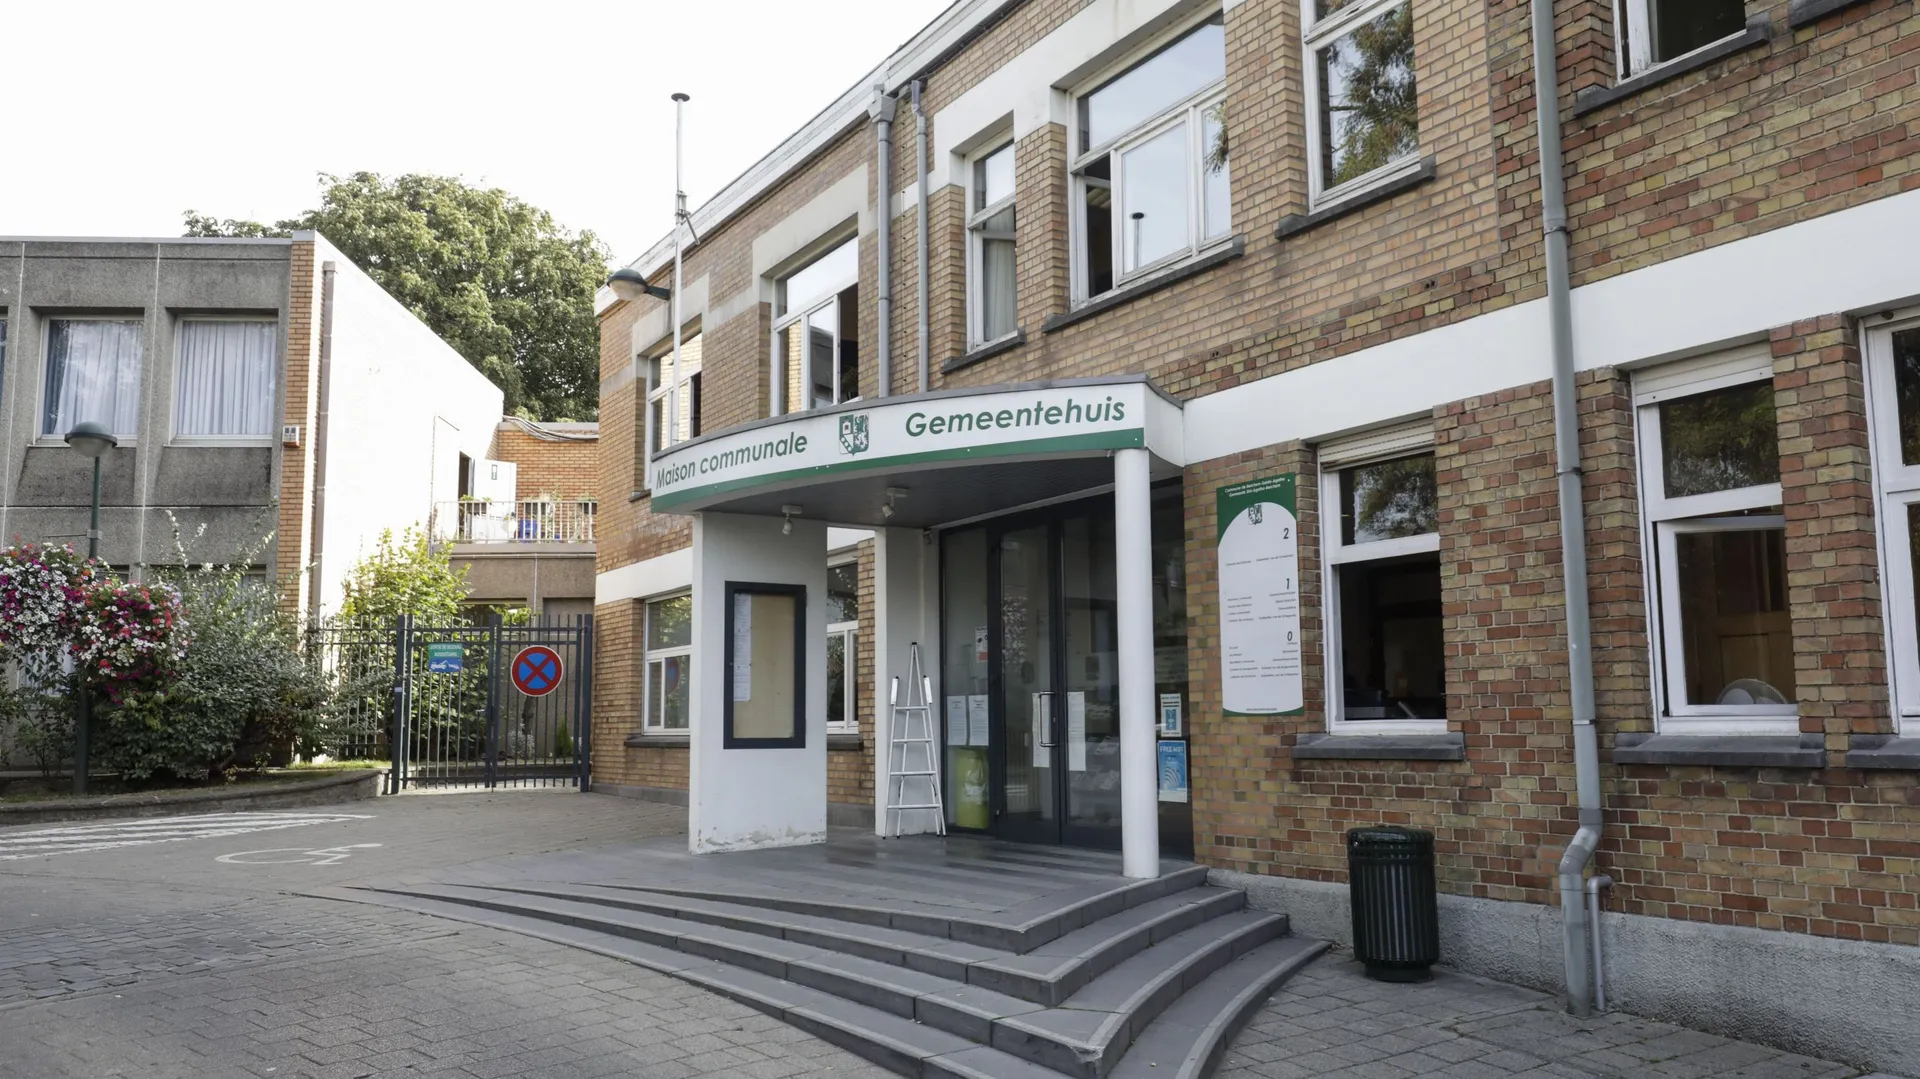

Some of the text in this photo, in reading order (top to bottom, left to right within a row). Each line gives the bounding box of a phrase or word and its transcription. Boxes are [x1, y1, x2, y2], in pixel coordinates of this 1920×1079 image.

[905, 395, 1126, 438] Gemeentehuis
[655, 430, 808, 490] Maison communale
[1283, 527, 1290, 540] 2
[1286, 578, 1291, 590] 1
[1287, 630, 1293, 642] 0
